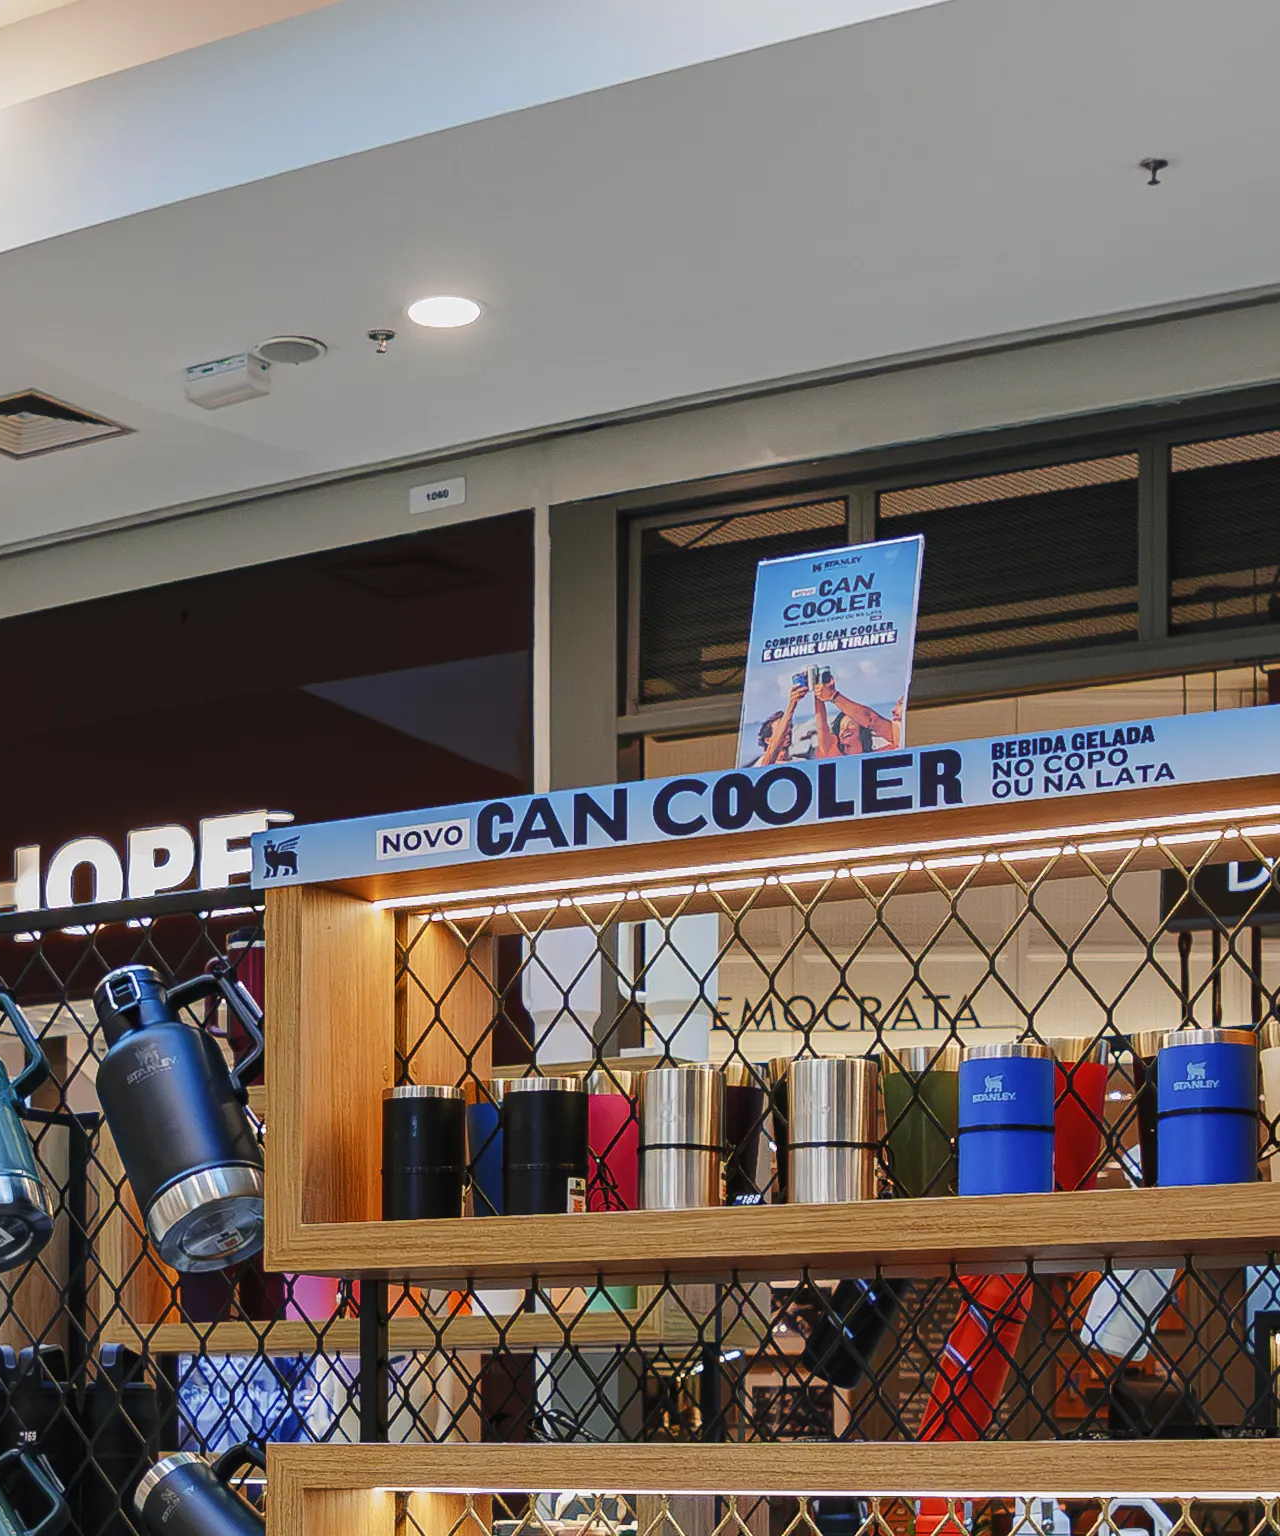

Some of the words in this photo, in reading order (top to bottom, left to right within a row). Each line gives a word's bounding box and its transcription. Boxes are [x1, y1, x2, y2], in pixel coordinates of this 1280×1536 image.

[819, 572, 875, 597] CAN
[783, 591, 882, 621] COOLER
[763, 649, 772, 661] E
[773, 641, 816, 659] GANHE
[818, 638, 838, 653] UM
[841, 630, 896, 650] TIRANTE
[765, 634, 810, 649] COMPRE
[826, 627, 847, 640] CAN
[850, 622, 895, 636] COOLER
[991, 735, 1067, 760] BEBIDA
[1071, 725, 1155, 751] GELADA
[992, 758, 1034, 780] NO
[1043, 748, 1128, 774] COPO
[991, 777, 1034, 799] OU
[1043, 773, 1086, 793] NA
[1096, 763, 1176, 788] LATA
[382, 825, 464, 854] NOVO
[476, 788, 628, 857] CAN
[652, 748, 964, 837] COOLER
[972, 1091, 1016, 1103] STANLEY
[1173, 1079, 1220, 1091] STANLEY
